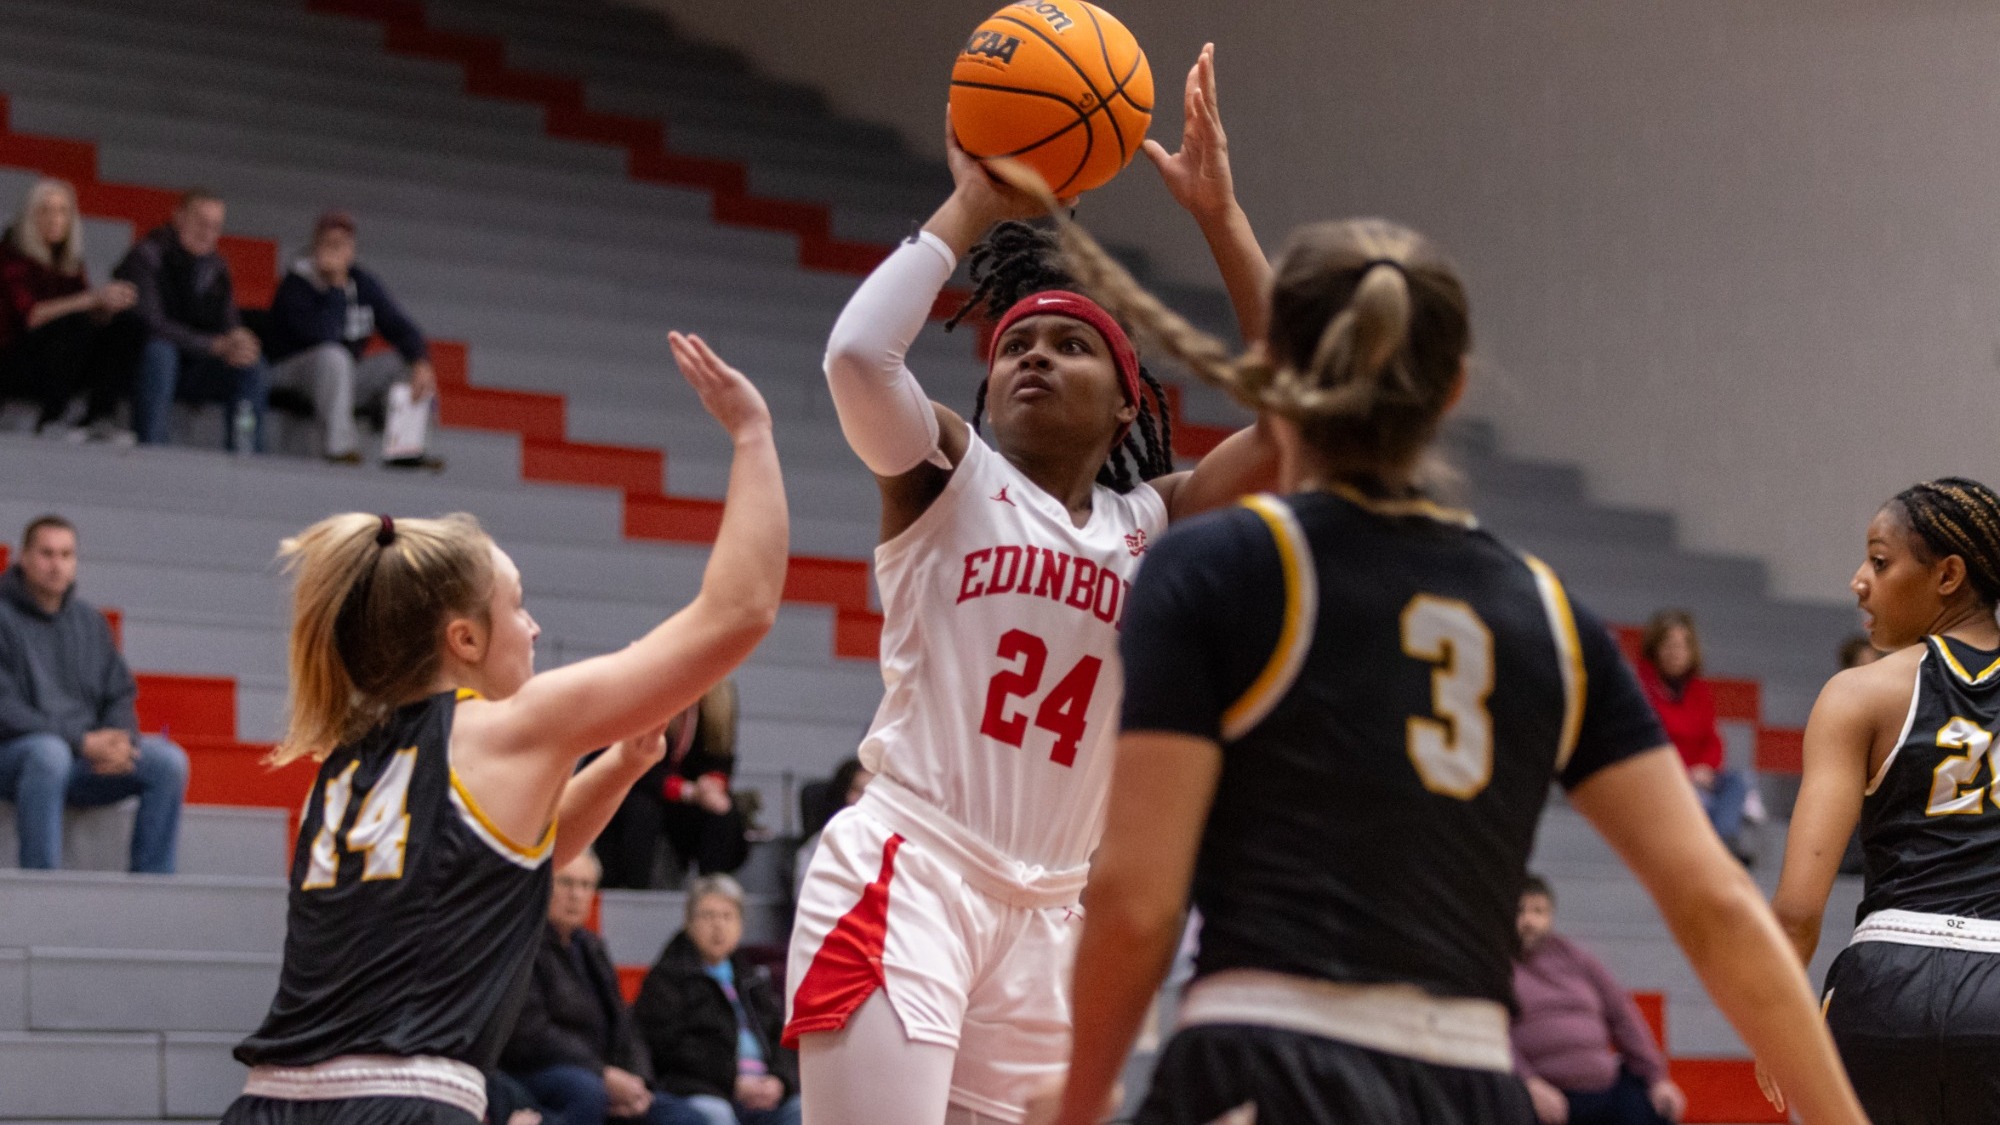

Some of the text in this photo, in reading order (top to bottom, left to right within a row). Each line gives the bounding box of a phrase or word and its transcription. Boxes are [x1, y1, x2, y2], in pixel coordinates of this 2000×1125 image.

[963, 31, 1021, 65] CAA
[980, 628, 1103, 768] 24
[1399, 592, 1496, 801] 3
[1925, 716, 2000, 816] 2
[301, 746, 419, 891] 14
